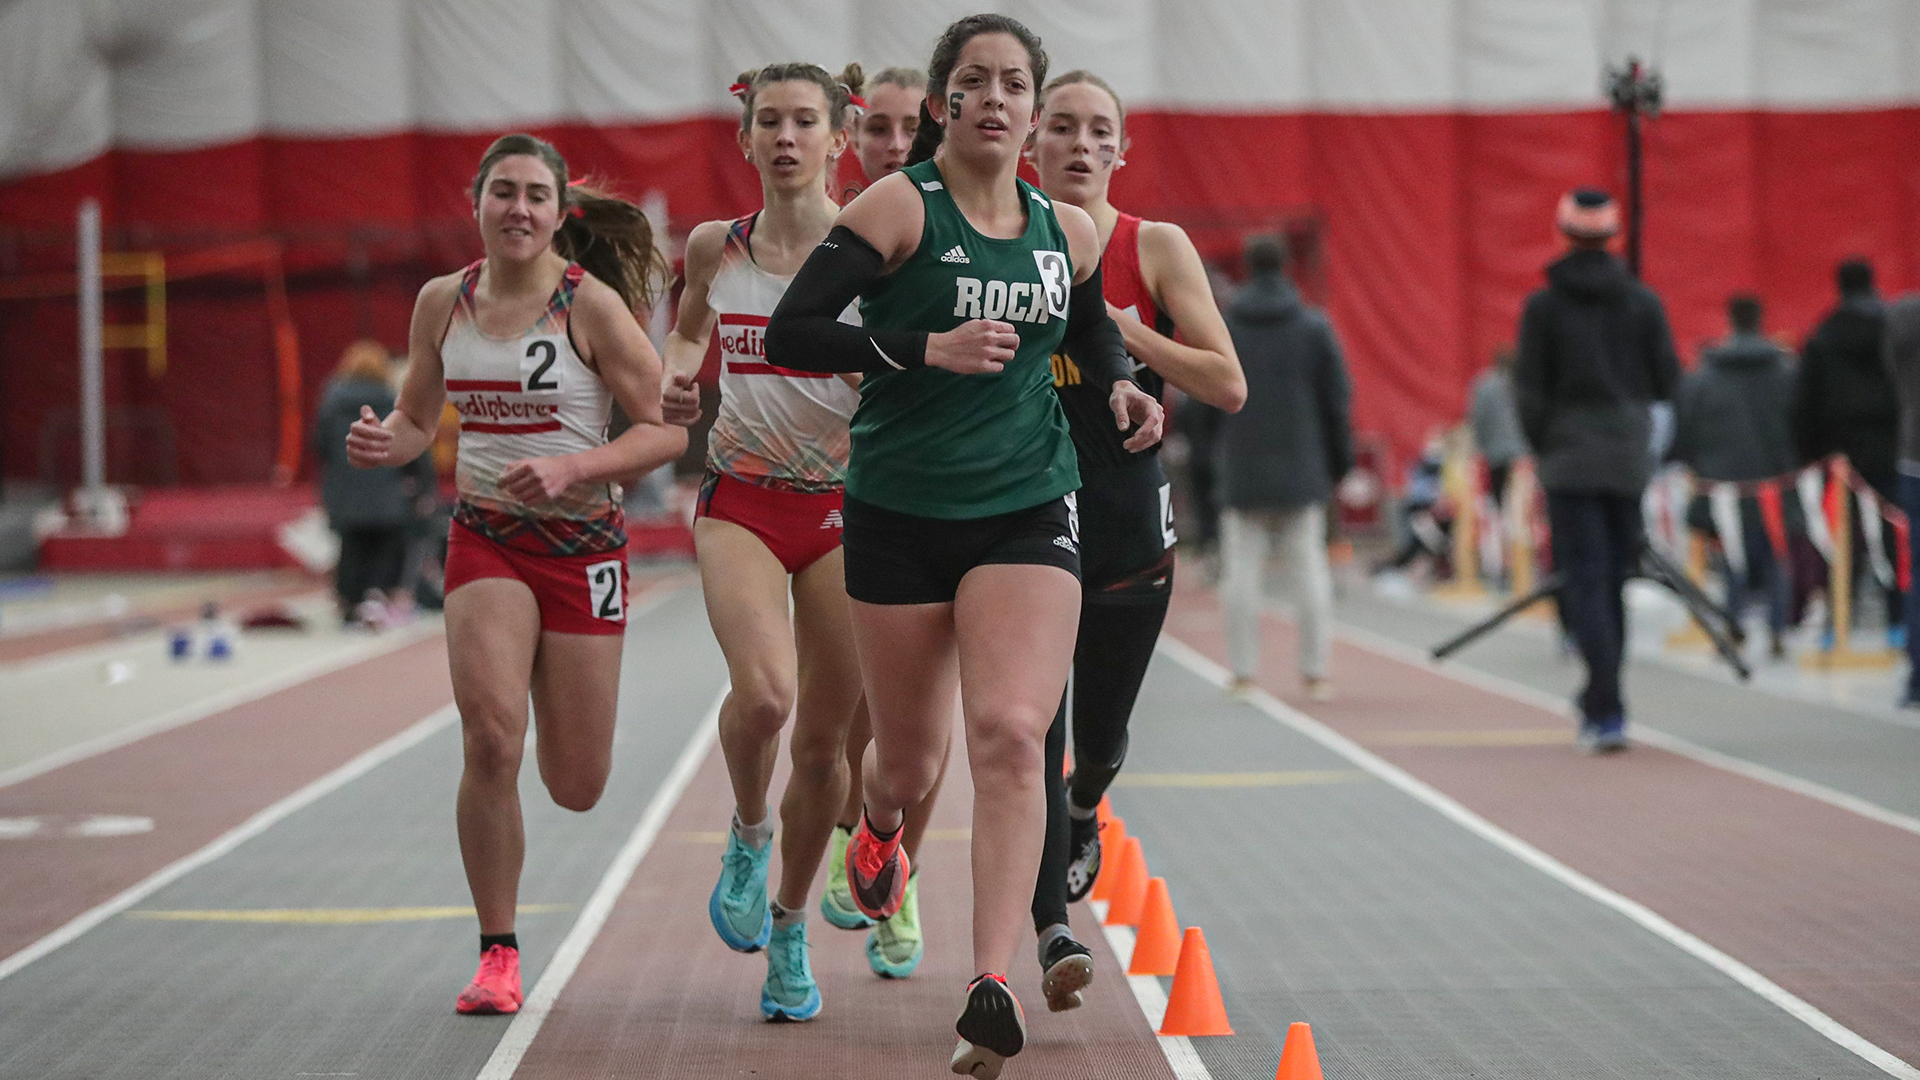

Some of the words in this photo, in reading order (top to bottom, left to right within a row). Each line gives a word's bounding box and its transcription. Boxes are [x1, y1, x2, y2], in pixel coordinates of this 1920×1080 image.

[940, 253, 970, 264] adidas
[1042, 254, 1067, 312] 3
[953, 276, 1050, 324] ROCK
[526, 340, 558, 391] 2
[595, 567, 619, 617] 2
